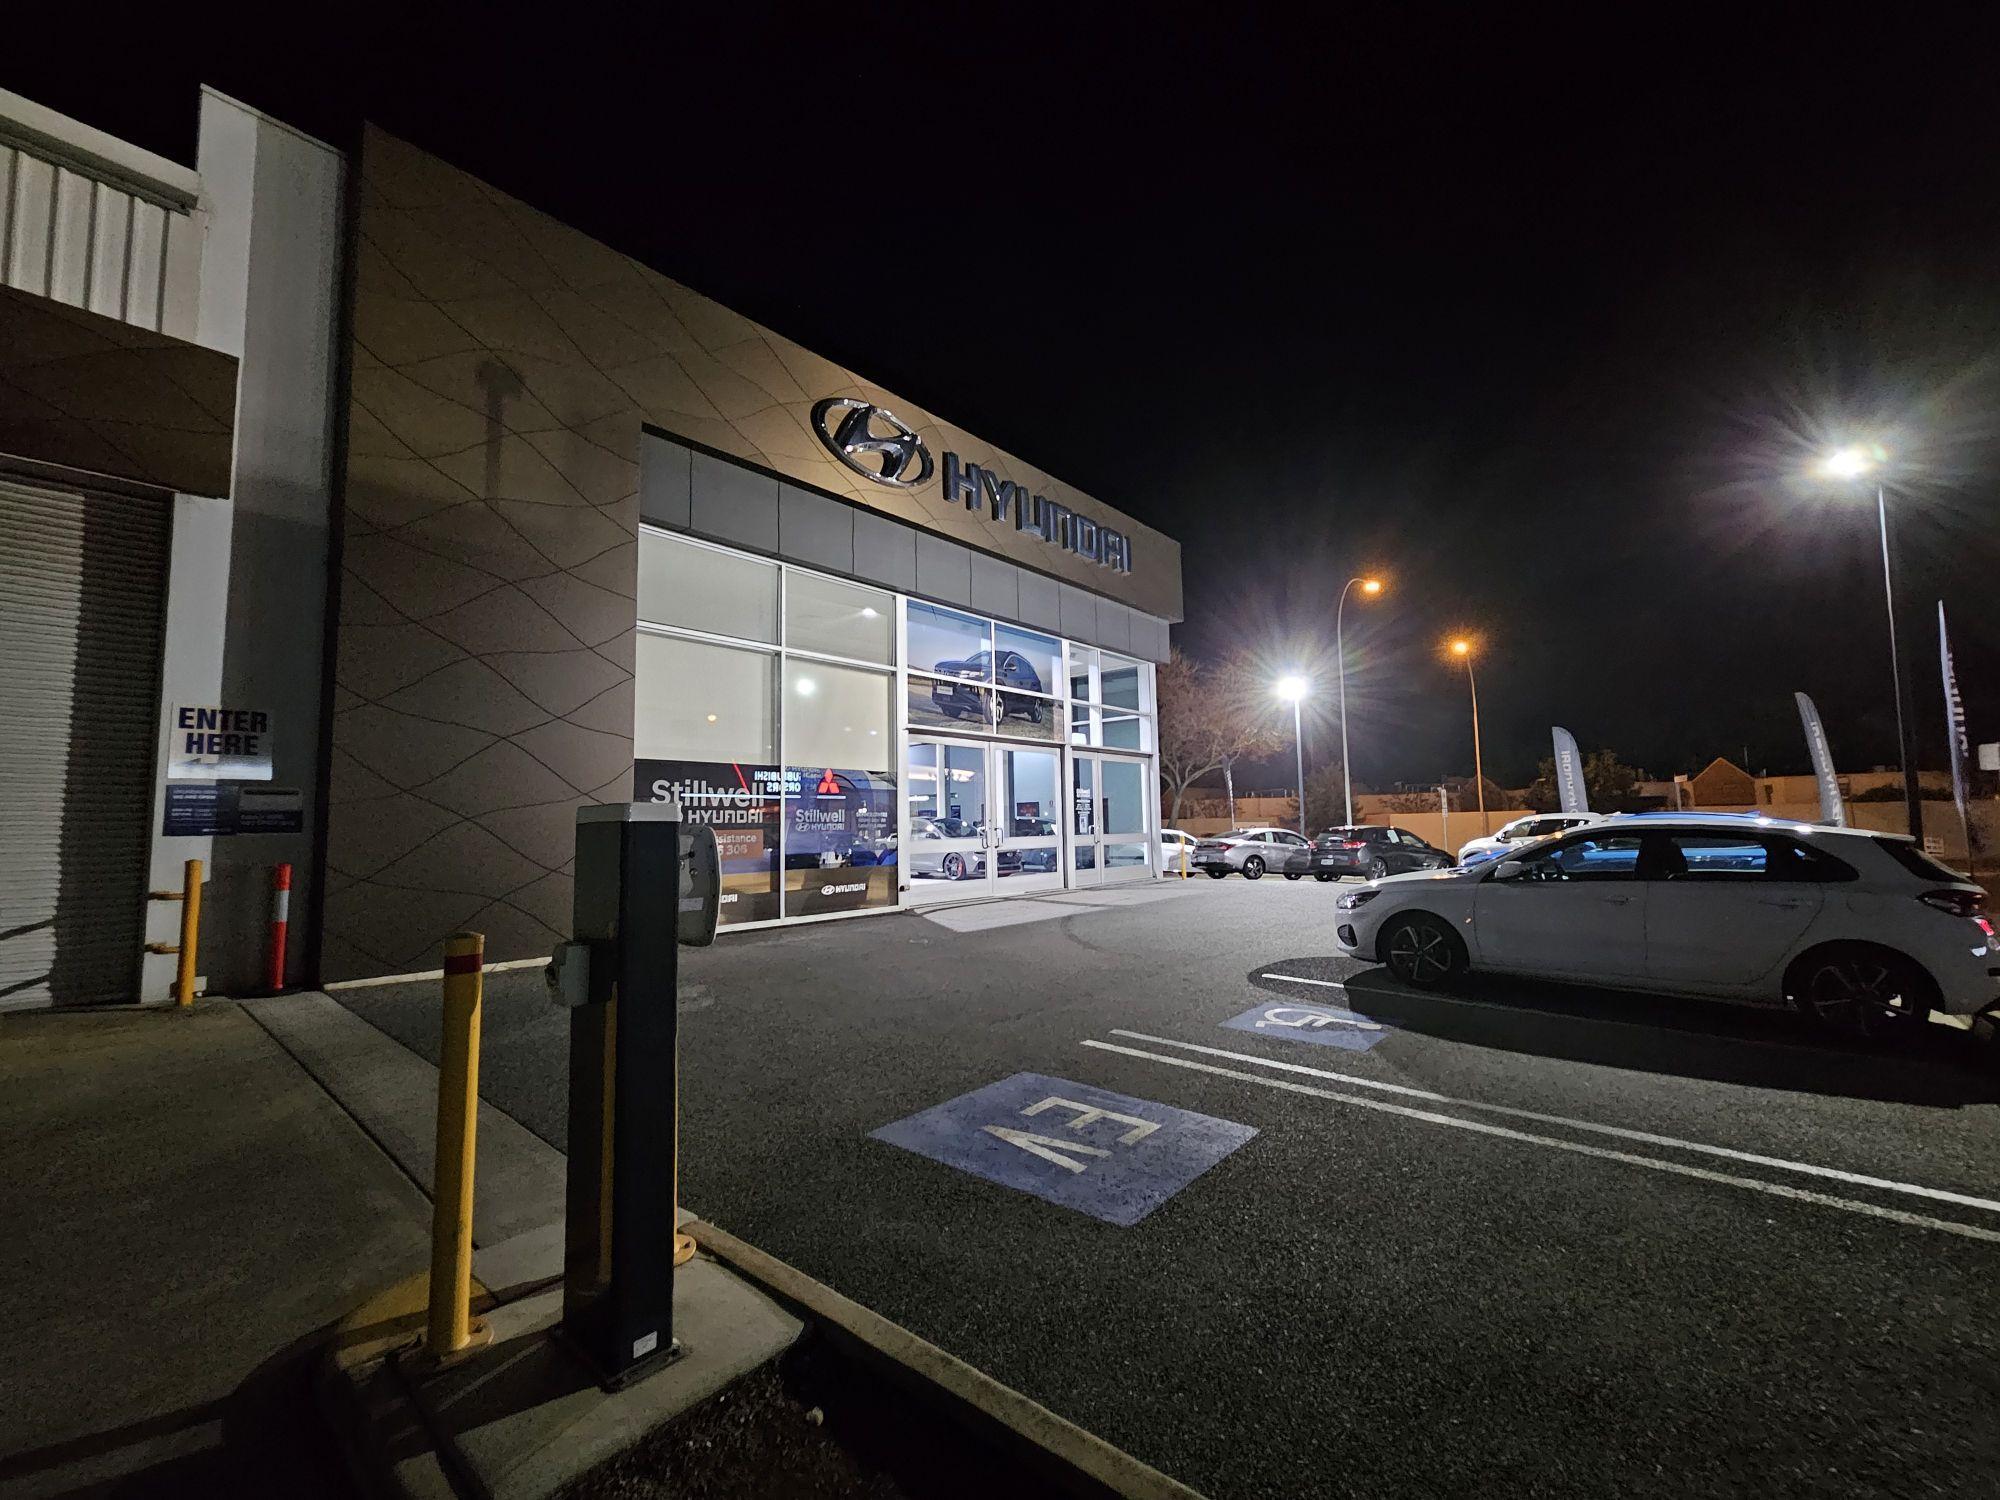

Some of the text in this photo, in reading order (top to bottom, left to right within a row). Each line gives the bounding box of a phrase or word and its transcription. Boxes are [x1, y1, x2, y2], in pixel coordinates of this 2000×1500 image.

[942, 451, 1132, 576] HYUNDAI
[178, 707, 267, 733] ENTER
[185, 733, 259, 755] HERE
[650, 779, 765, 807] Stillwell
[687, 809, 764, 824] HYUNDAI
[795, 808, 845, 822] Stillwell
[811, 823, 845, 831] HYUNDAI
[835, 883, 866, 893] HYUNDAI
[979, 1096, 1162, 1174] EV
